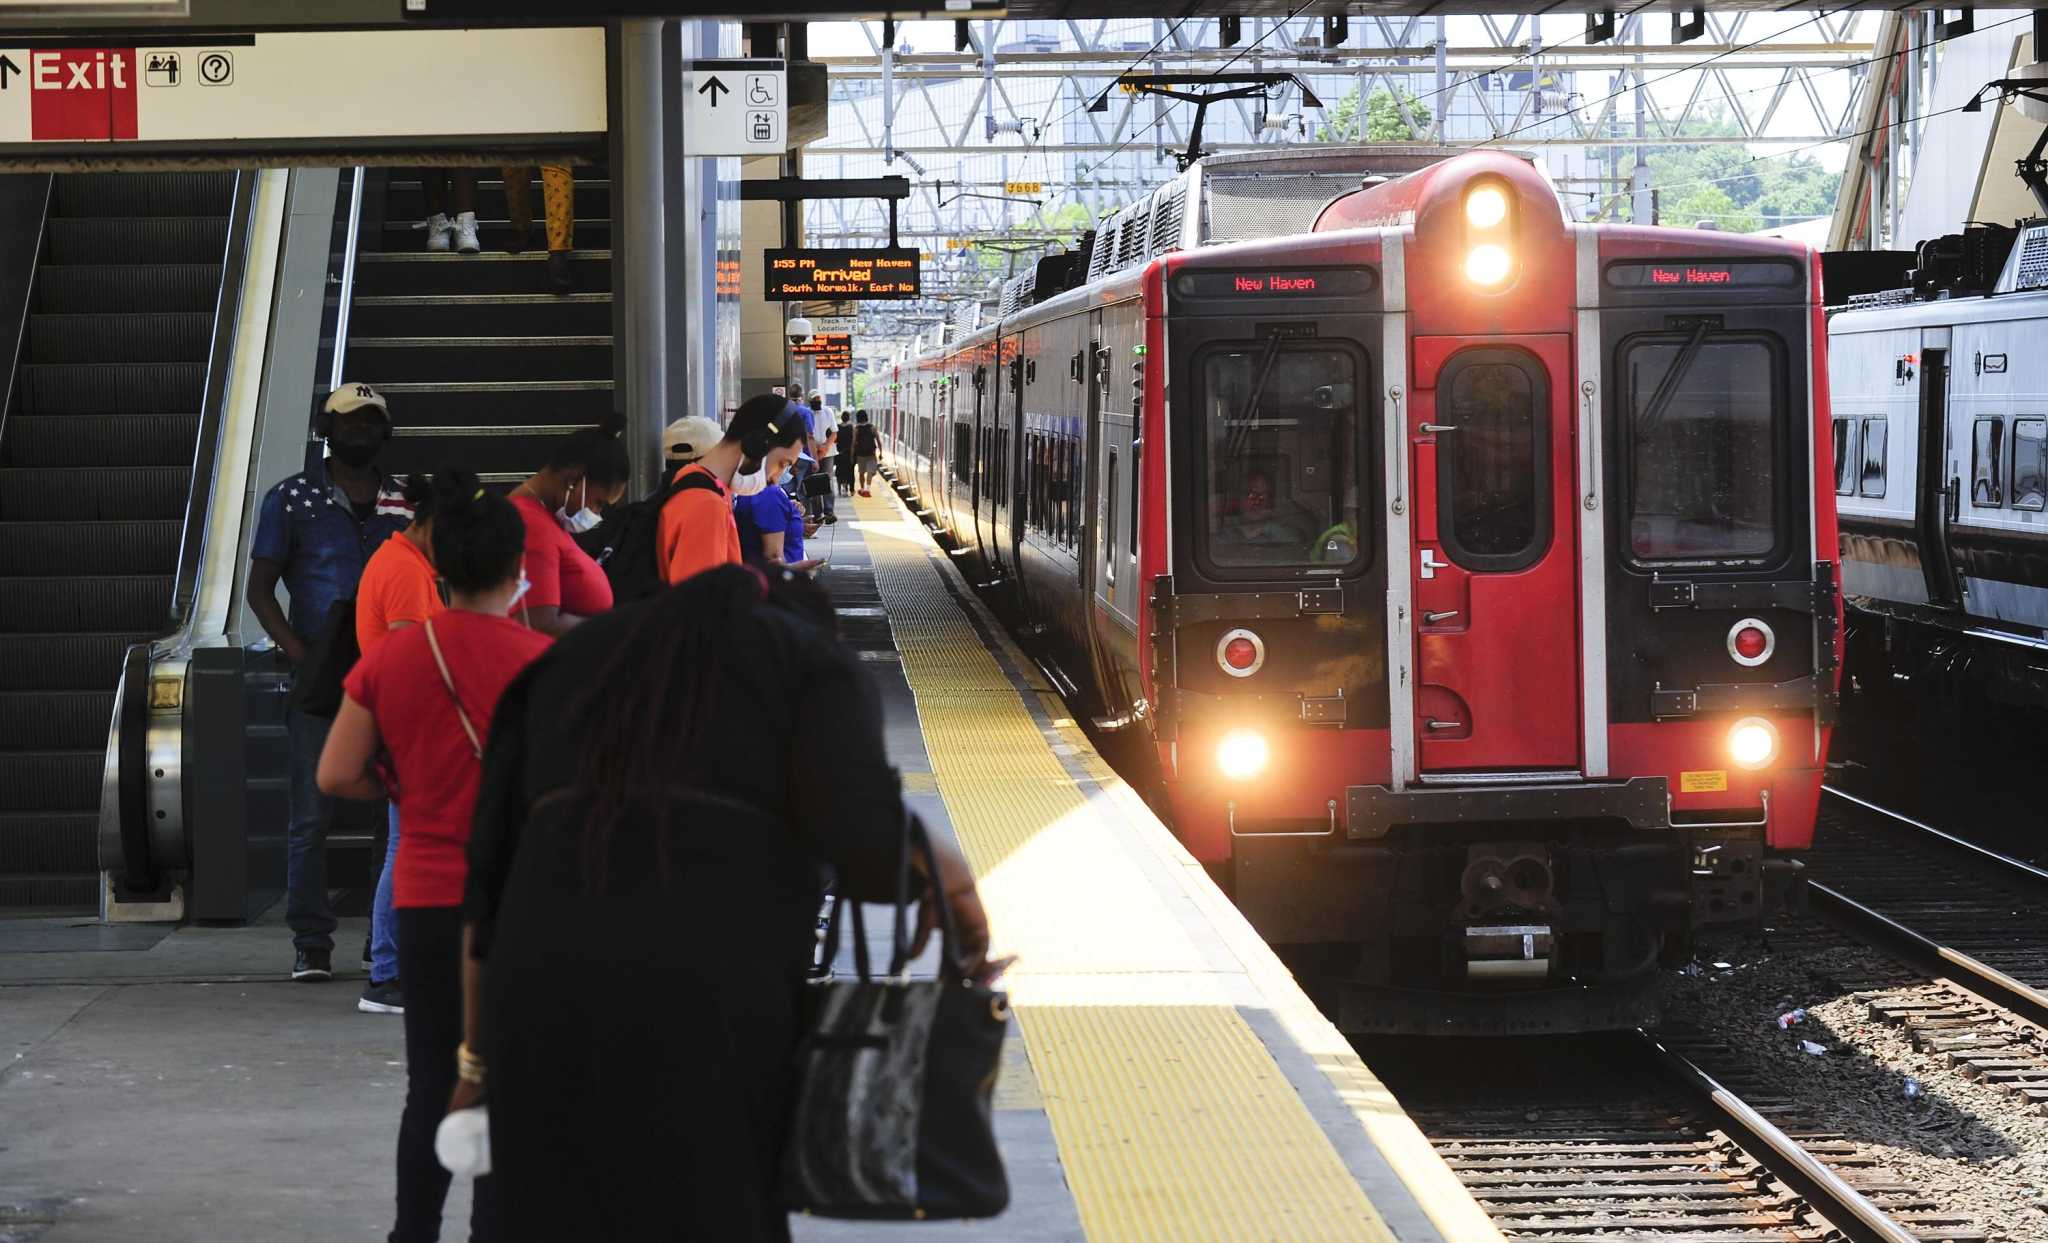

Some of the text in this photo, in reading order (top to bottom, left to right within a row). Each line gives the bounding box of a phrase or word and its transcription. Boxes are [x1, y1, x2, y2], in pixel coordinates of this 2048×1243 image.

[34, 52, 127, 90] Exit
[1488, 74, 1514, 91] EY
[773, 259, 912, 268] 1:55 PM New Haven
[813, 269, 871, 281] Arrived
[1653, 268, 1730, 283] New Haven
[782, 284, 813, 293] South
[817, 284, 864, 293] Norwalk,
[869, 283, 894, 292] East
[1235, 276, 1315, 291] New Haven
